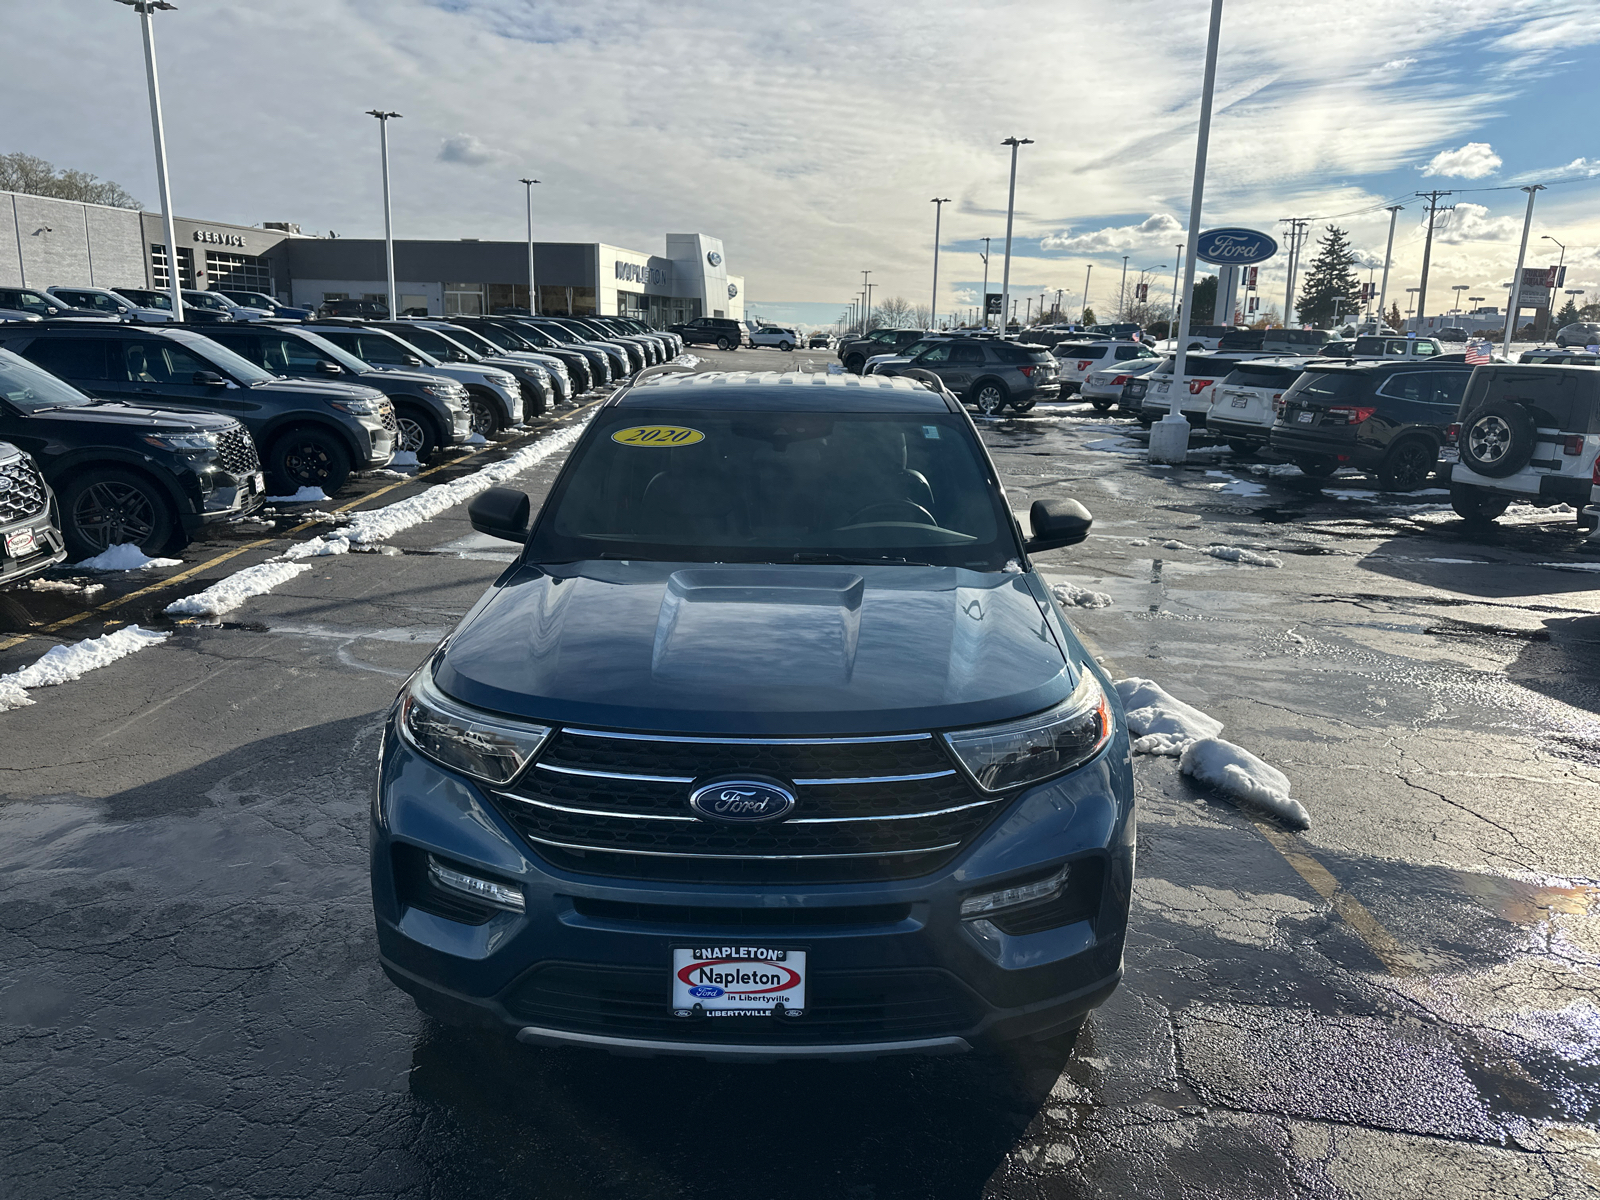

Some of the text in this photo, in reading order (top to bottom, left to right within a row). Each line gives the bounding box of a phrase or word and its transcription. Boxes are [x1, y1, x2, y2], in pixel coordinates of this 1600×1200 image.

[196, 230, 247, 247] SERVICE
[1208, 235, 1261, 257] Ford
[615, 260, 667, 286] NAPLETON
[624, 429, 692, 442] 2020
[714, 789, 770, 813] Ford
[701, 947, 778, 960] NAPLETON
[699, 967, 781, 988] Napleton
[695, 987, 718, 997] Ford
[738, 995, 790, 1004] Libertyville
